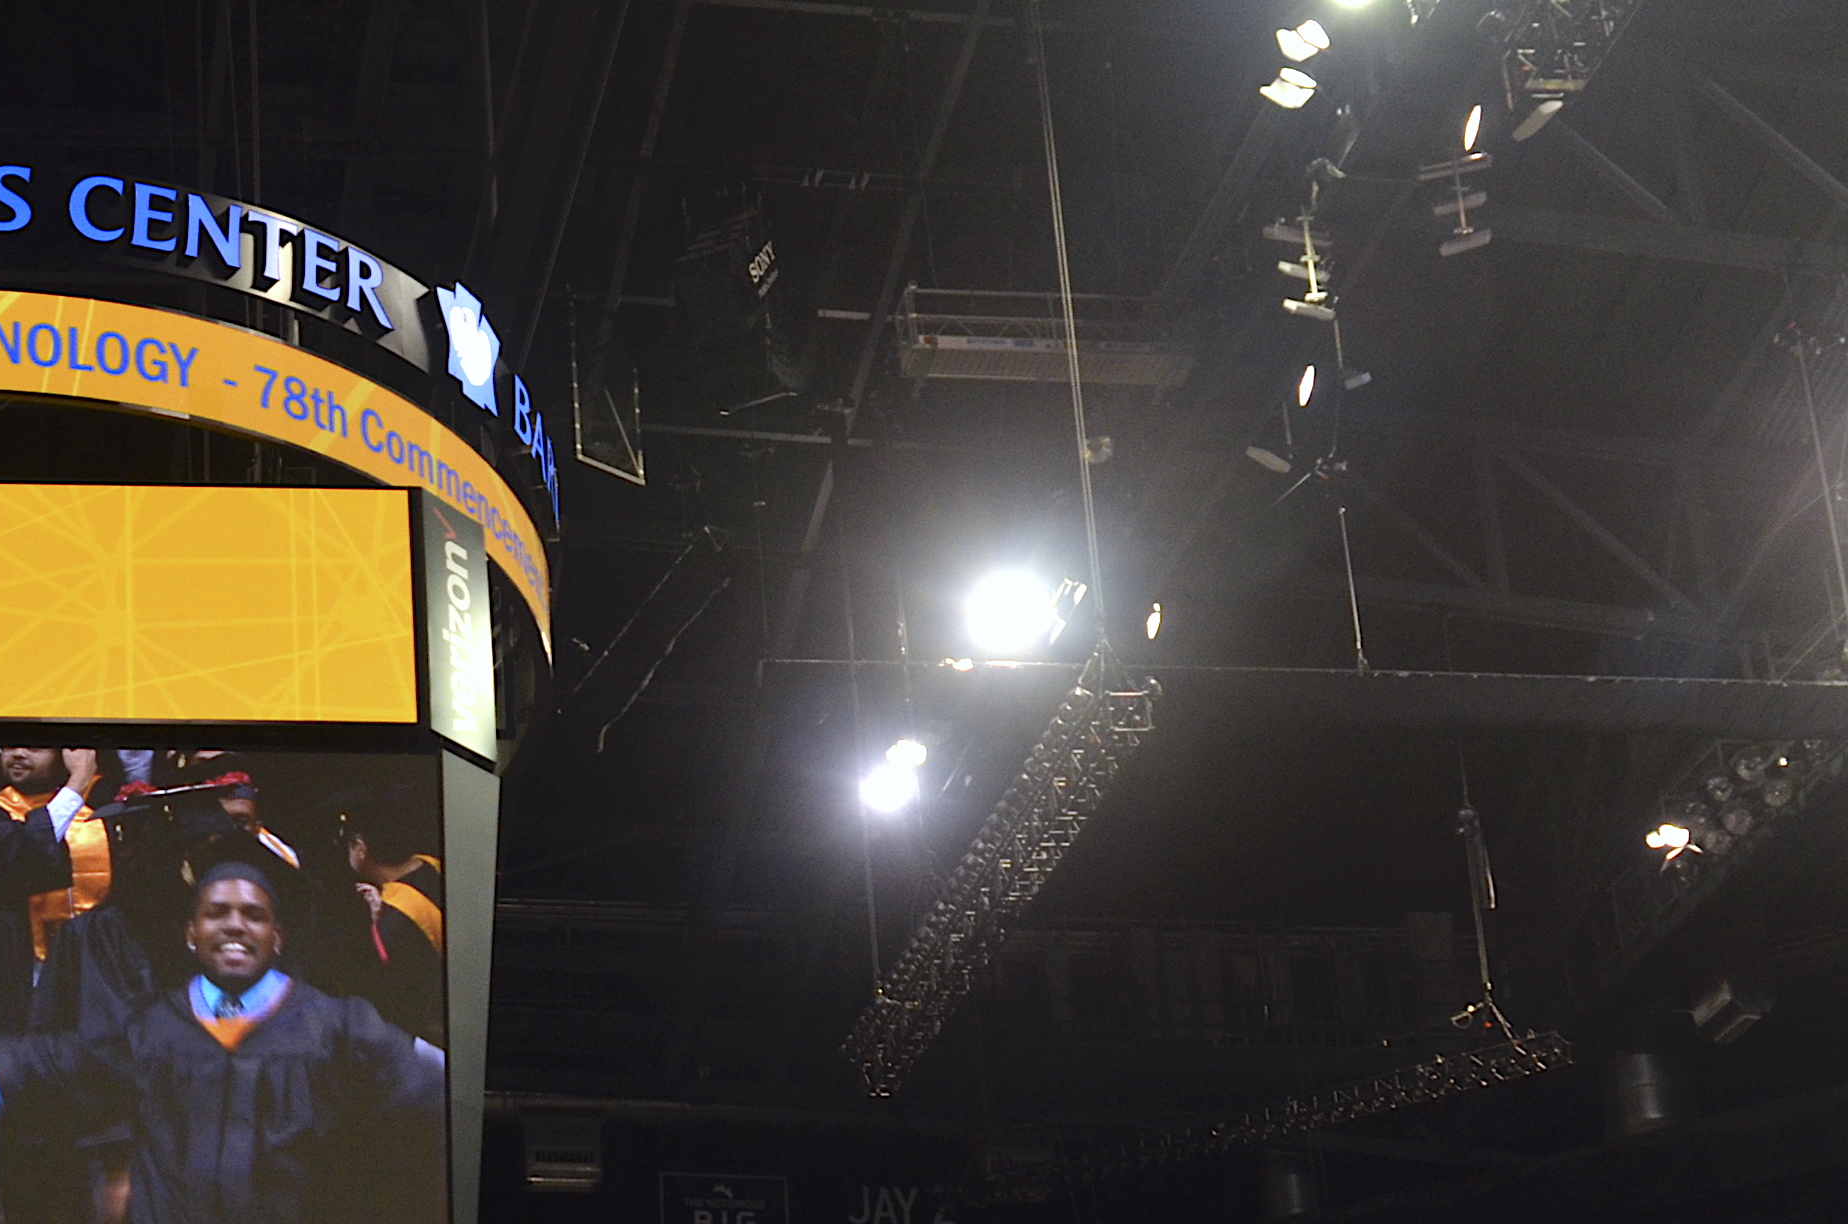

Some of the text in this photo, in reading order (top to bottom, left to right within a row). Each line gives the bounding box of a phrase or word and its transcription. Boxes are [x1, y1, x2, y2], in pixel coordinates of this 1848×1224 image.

[68, 175, 394, 330] CENTER
[747, 240, 776, 284] SONY
[254, 365, 349, 439] 78th
[443, 541, 477, 732] verizon
